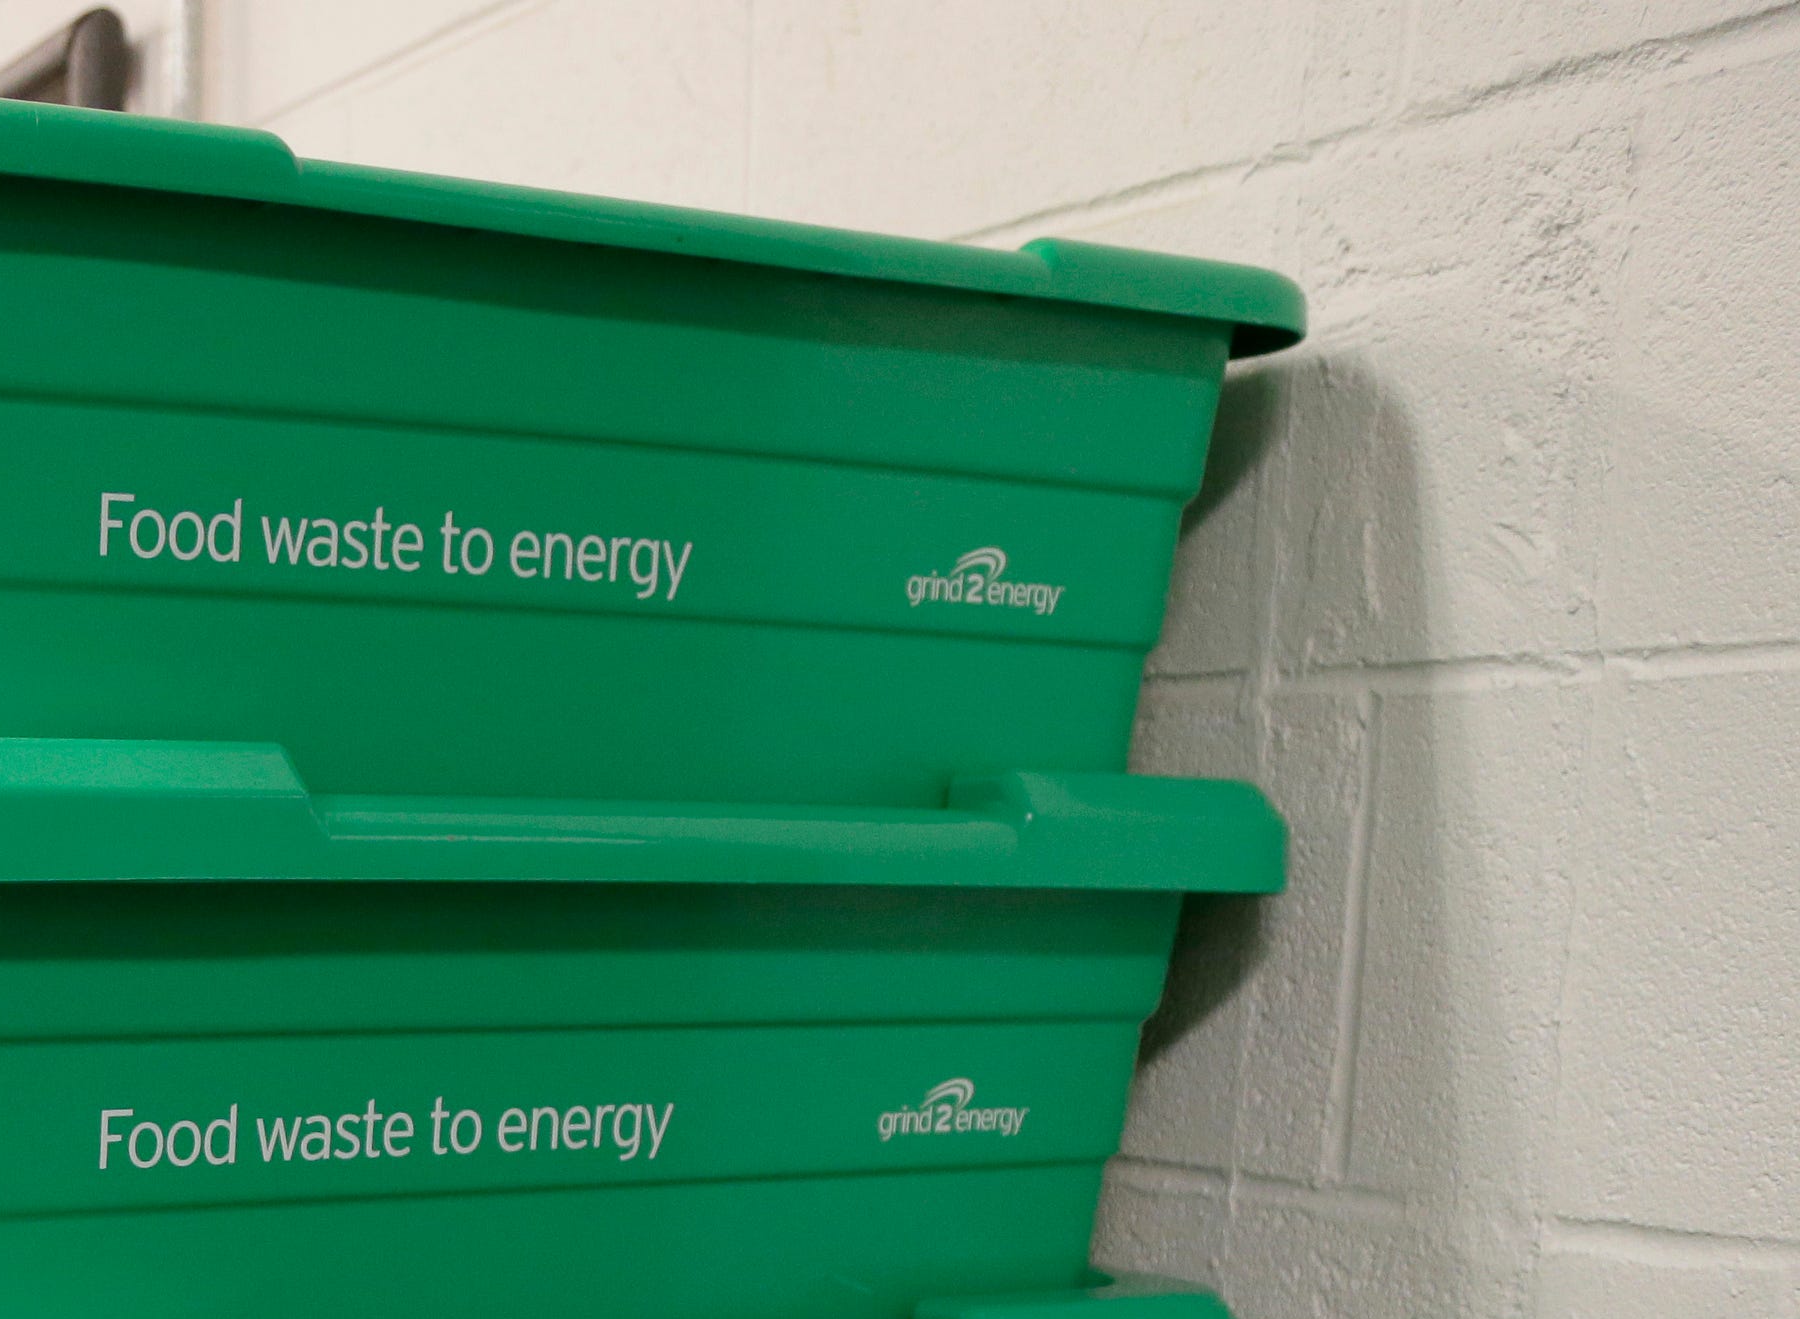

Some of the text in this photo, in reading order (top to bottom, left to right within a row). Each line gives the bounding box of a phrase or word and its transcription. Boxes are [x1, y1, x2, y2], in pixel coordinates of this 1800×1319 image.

[98, 491, 694, 601] Food waste to energy
[98, 1095, 674, 1170] Food waste to energy
